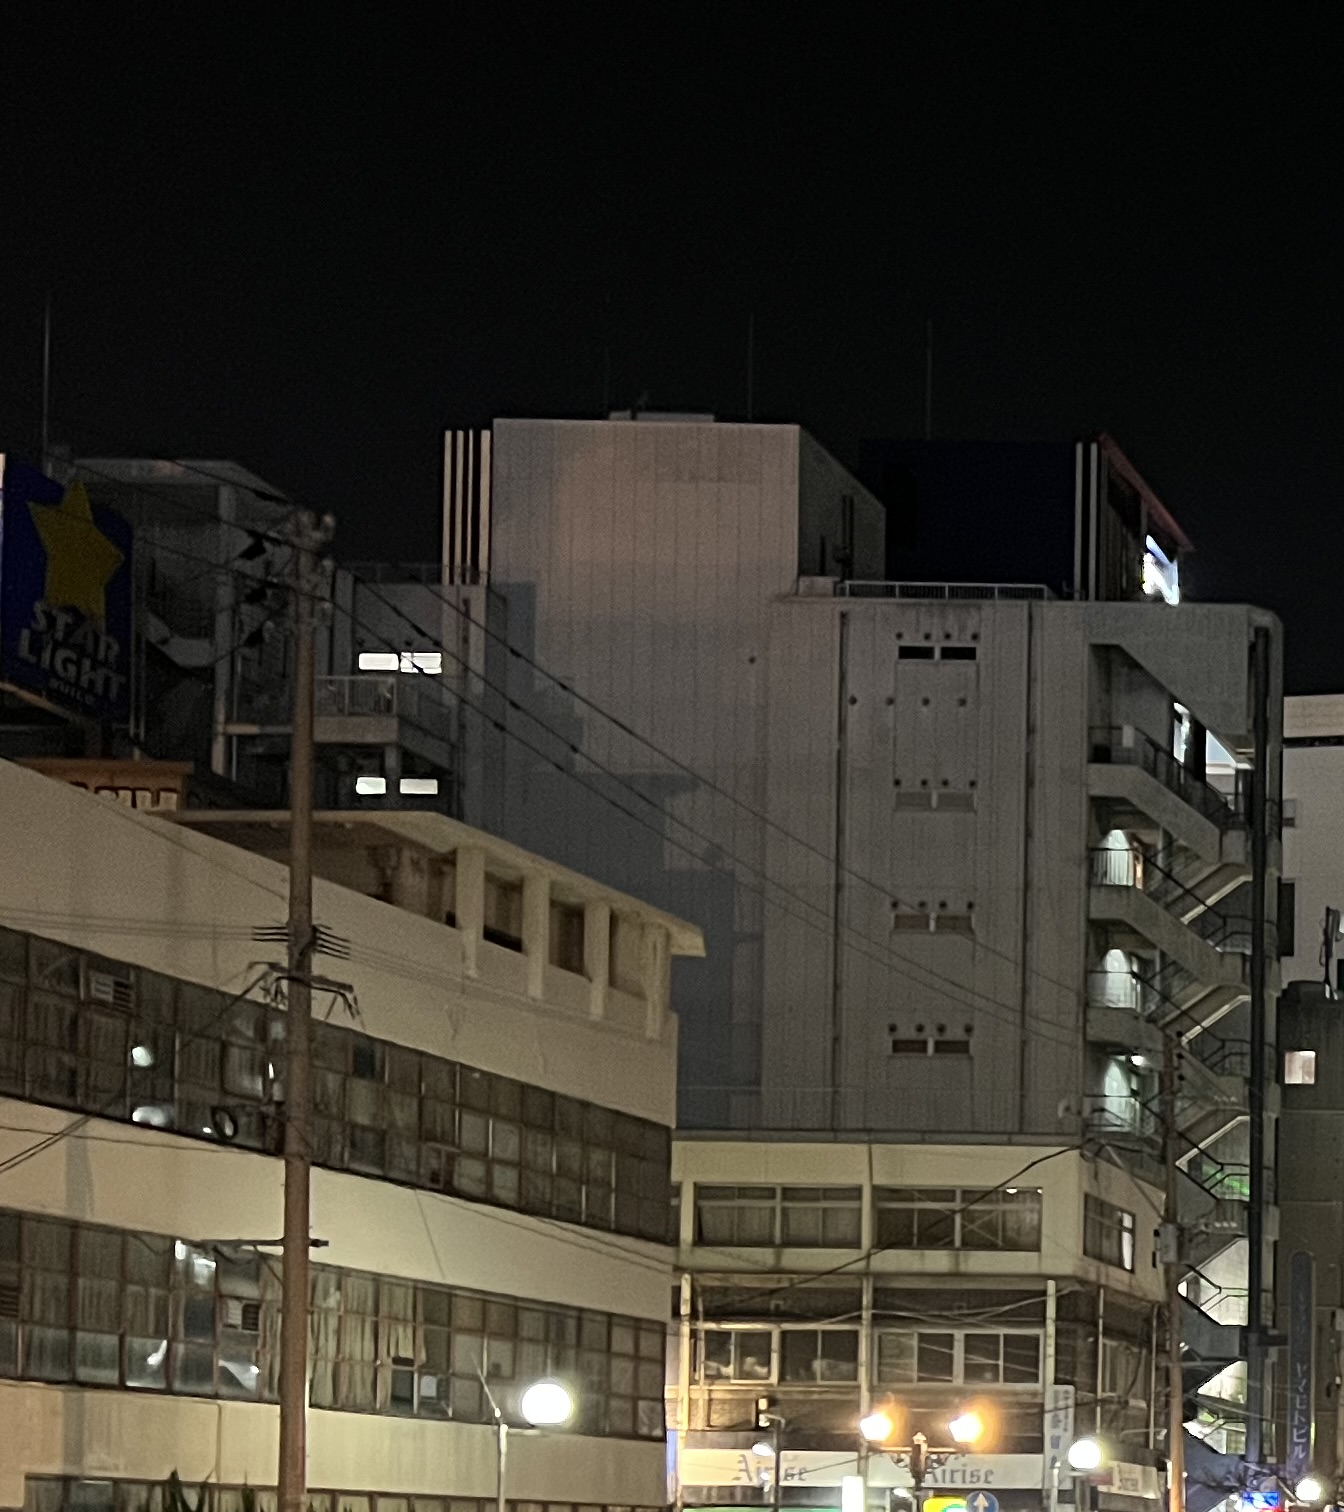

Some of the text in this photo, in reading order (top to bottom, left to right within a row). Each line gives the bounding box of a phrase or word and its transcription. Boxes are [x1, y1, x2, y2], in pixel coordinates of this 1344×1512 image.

[18, 628, 126, 702] LIGHT
[31, 601, 120, 669] STAR
[731, 1453, 807, 1482] Aise
